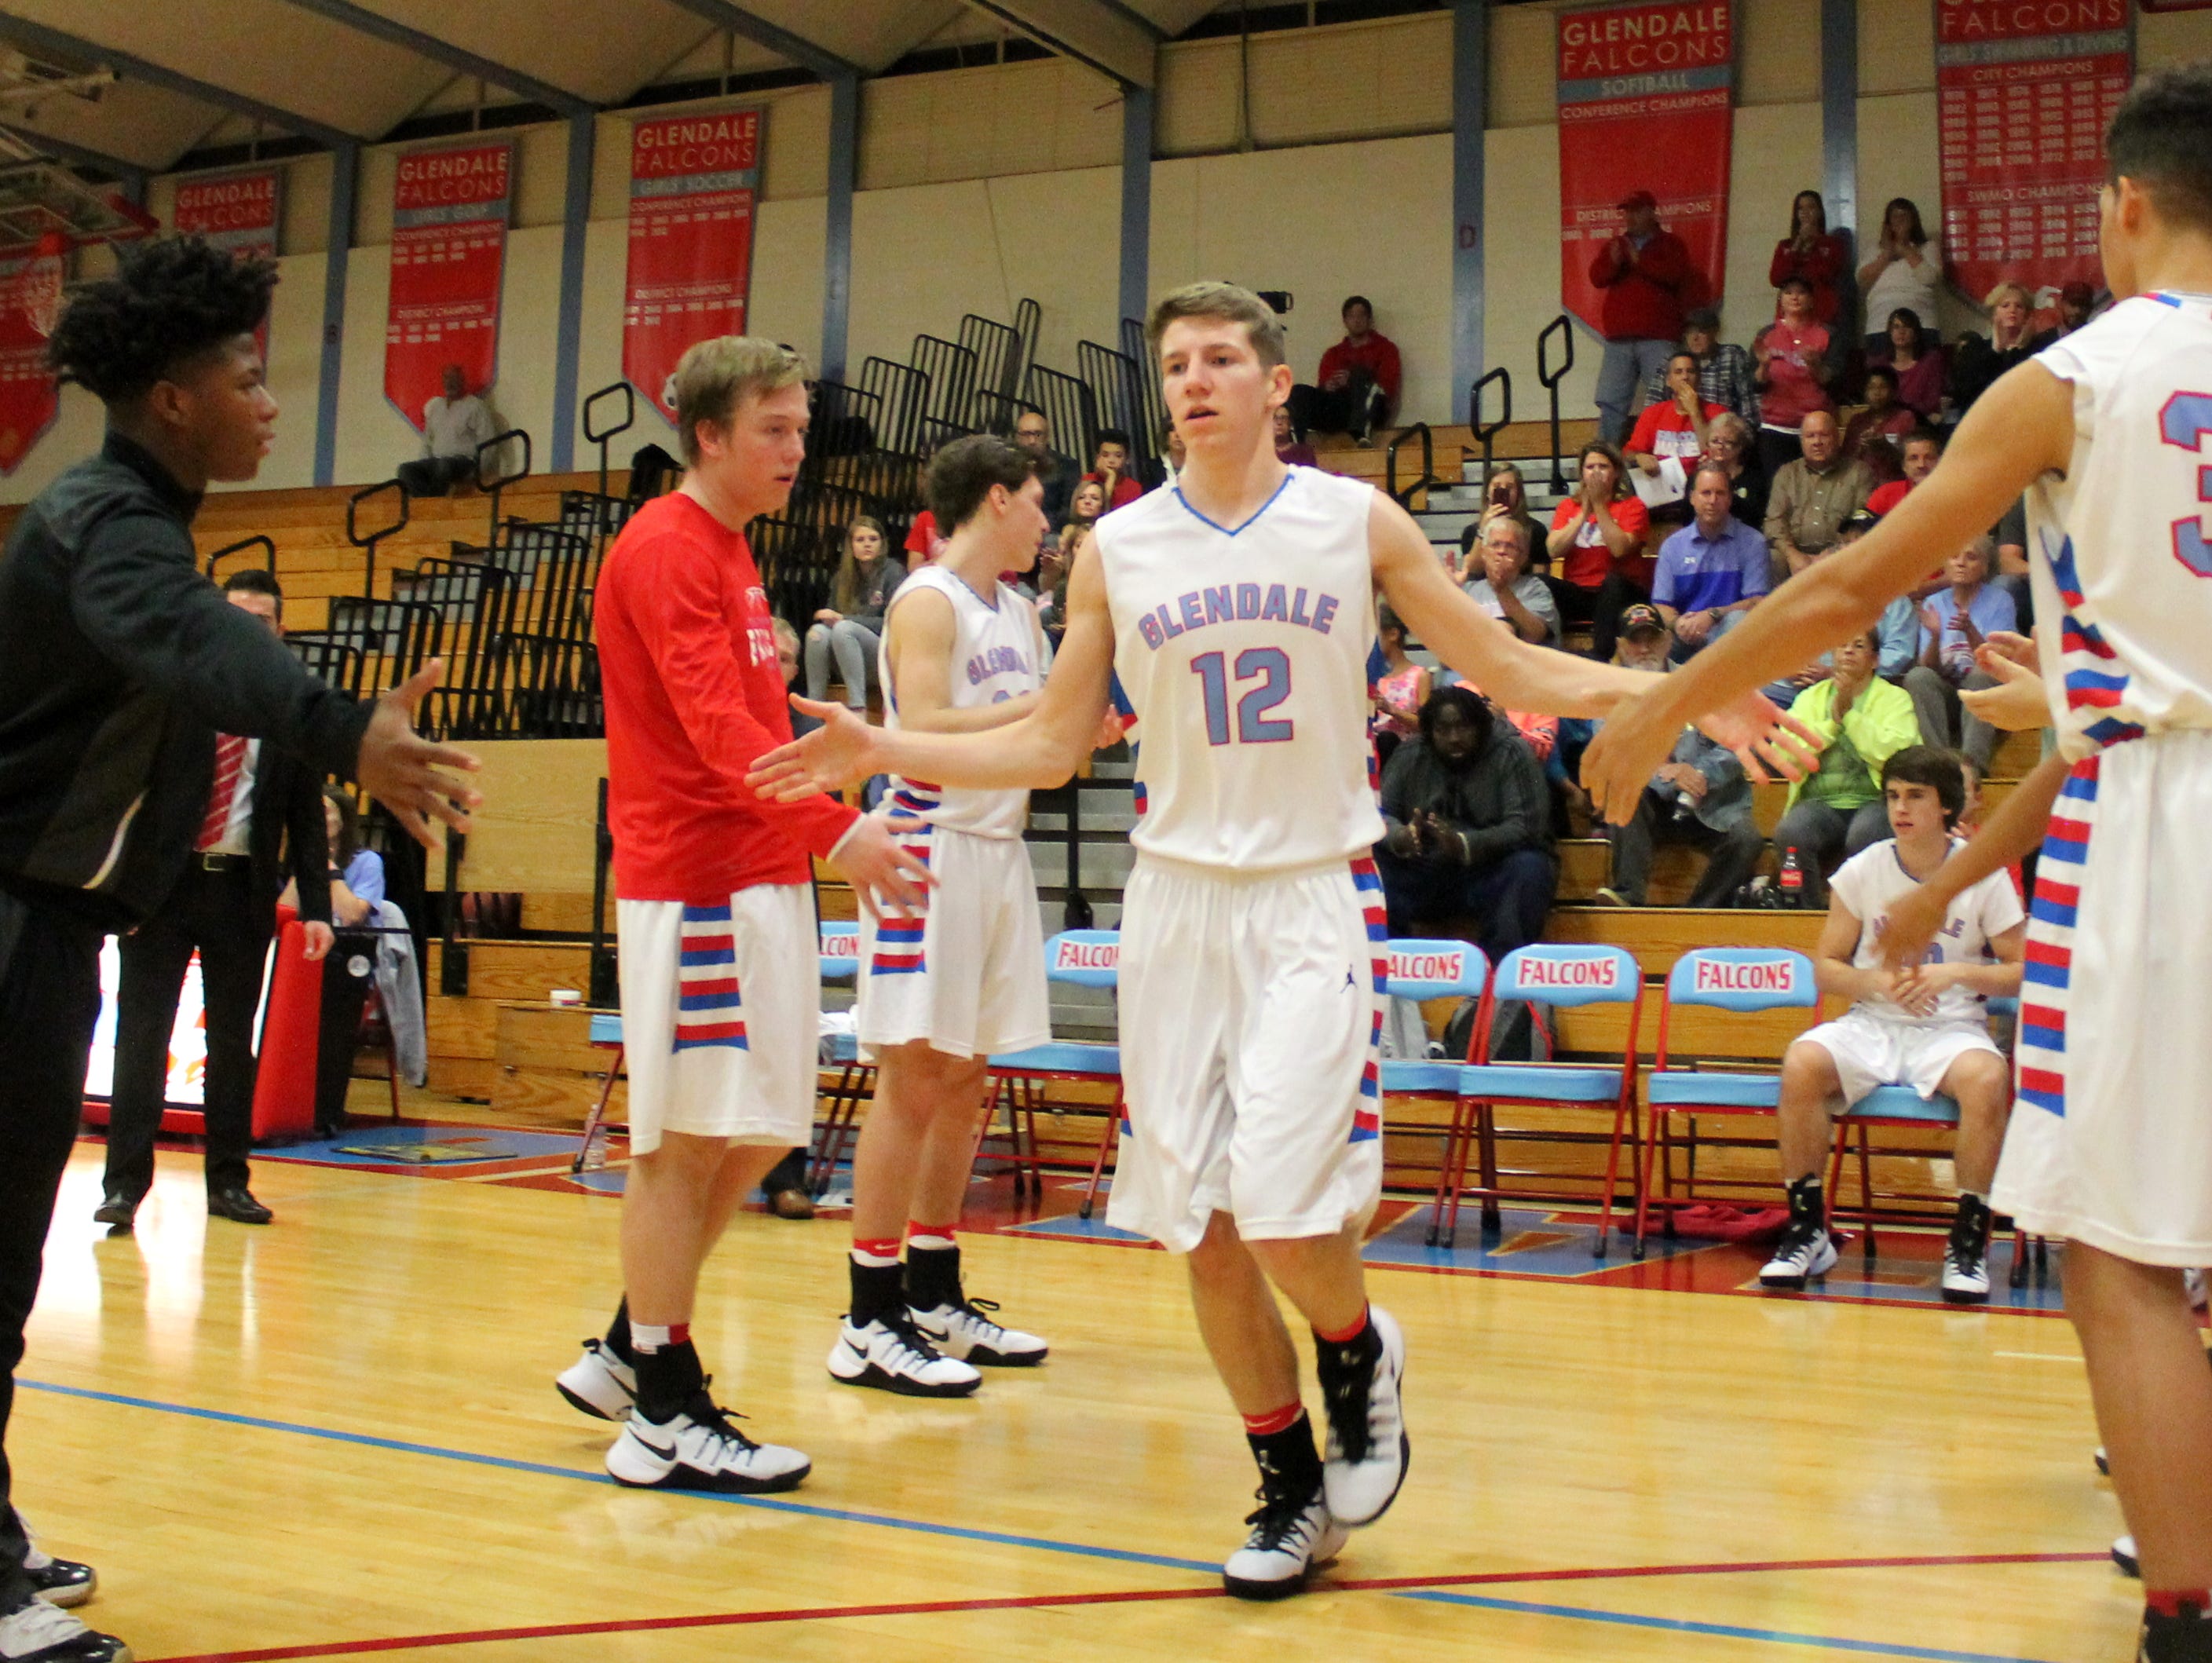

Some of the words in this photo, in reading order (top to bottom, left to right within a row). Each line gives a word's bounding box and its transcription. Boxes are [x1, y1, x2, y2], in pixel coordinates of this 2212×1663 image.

[1563, 7, 1728, 46] GLENDALE
[1942, 0, 2121, 34] FALCONS
[1563, 36, 1726, 73] FALCONS
[1601, 73, 1688, 95] SOFTBALL
[1973, 68, 2002, 80] CITY
[2006, 61, 2093, 79] CHAMPIONS
[1561, 102, 1646, 119] CONFERENCE
[1650, 92, 1728, 111] CHAMPIONS
[637, 118, 756, 148] GLENDALE
[400, 152, 507, 181] GLENDALE
[634, 143, 753, 172] FALCONS
[178, 179, 274, 208] GLENDALE
[396, 175, 505, 204] FALCONS
[694, 192, 751, 207] CHAMPIONS
[2017, 181, 2104, 199] CHAMPIONS
[1577, 208, 1627, 222] DISTRIC
[1654, 200, 1713, 217] AMPIONS
[1138, 583, 1339, 651] GLENDALE
[1190, 646, 1294, 746] 12
[1058, 942, 1120, 967] FALCO
[1387, 953, 1461, 981] ALCONS
[1519, 958, 1615, 986] FALCONS
[1698, 961, 1792, 990] FALCONS
